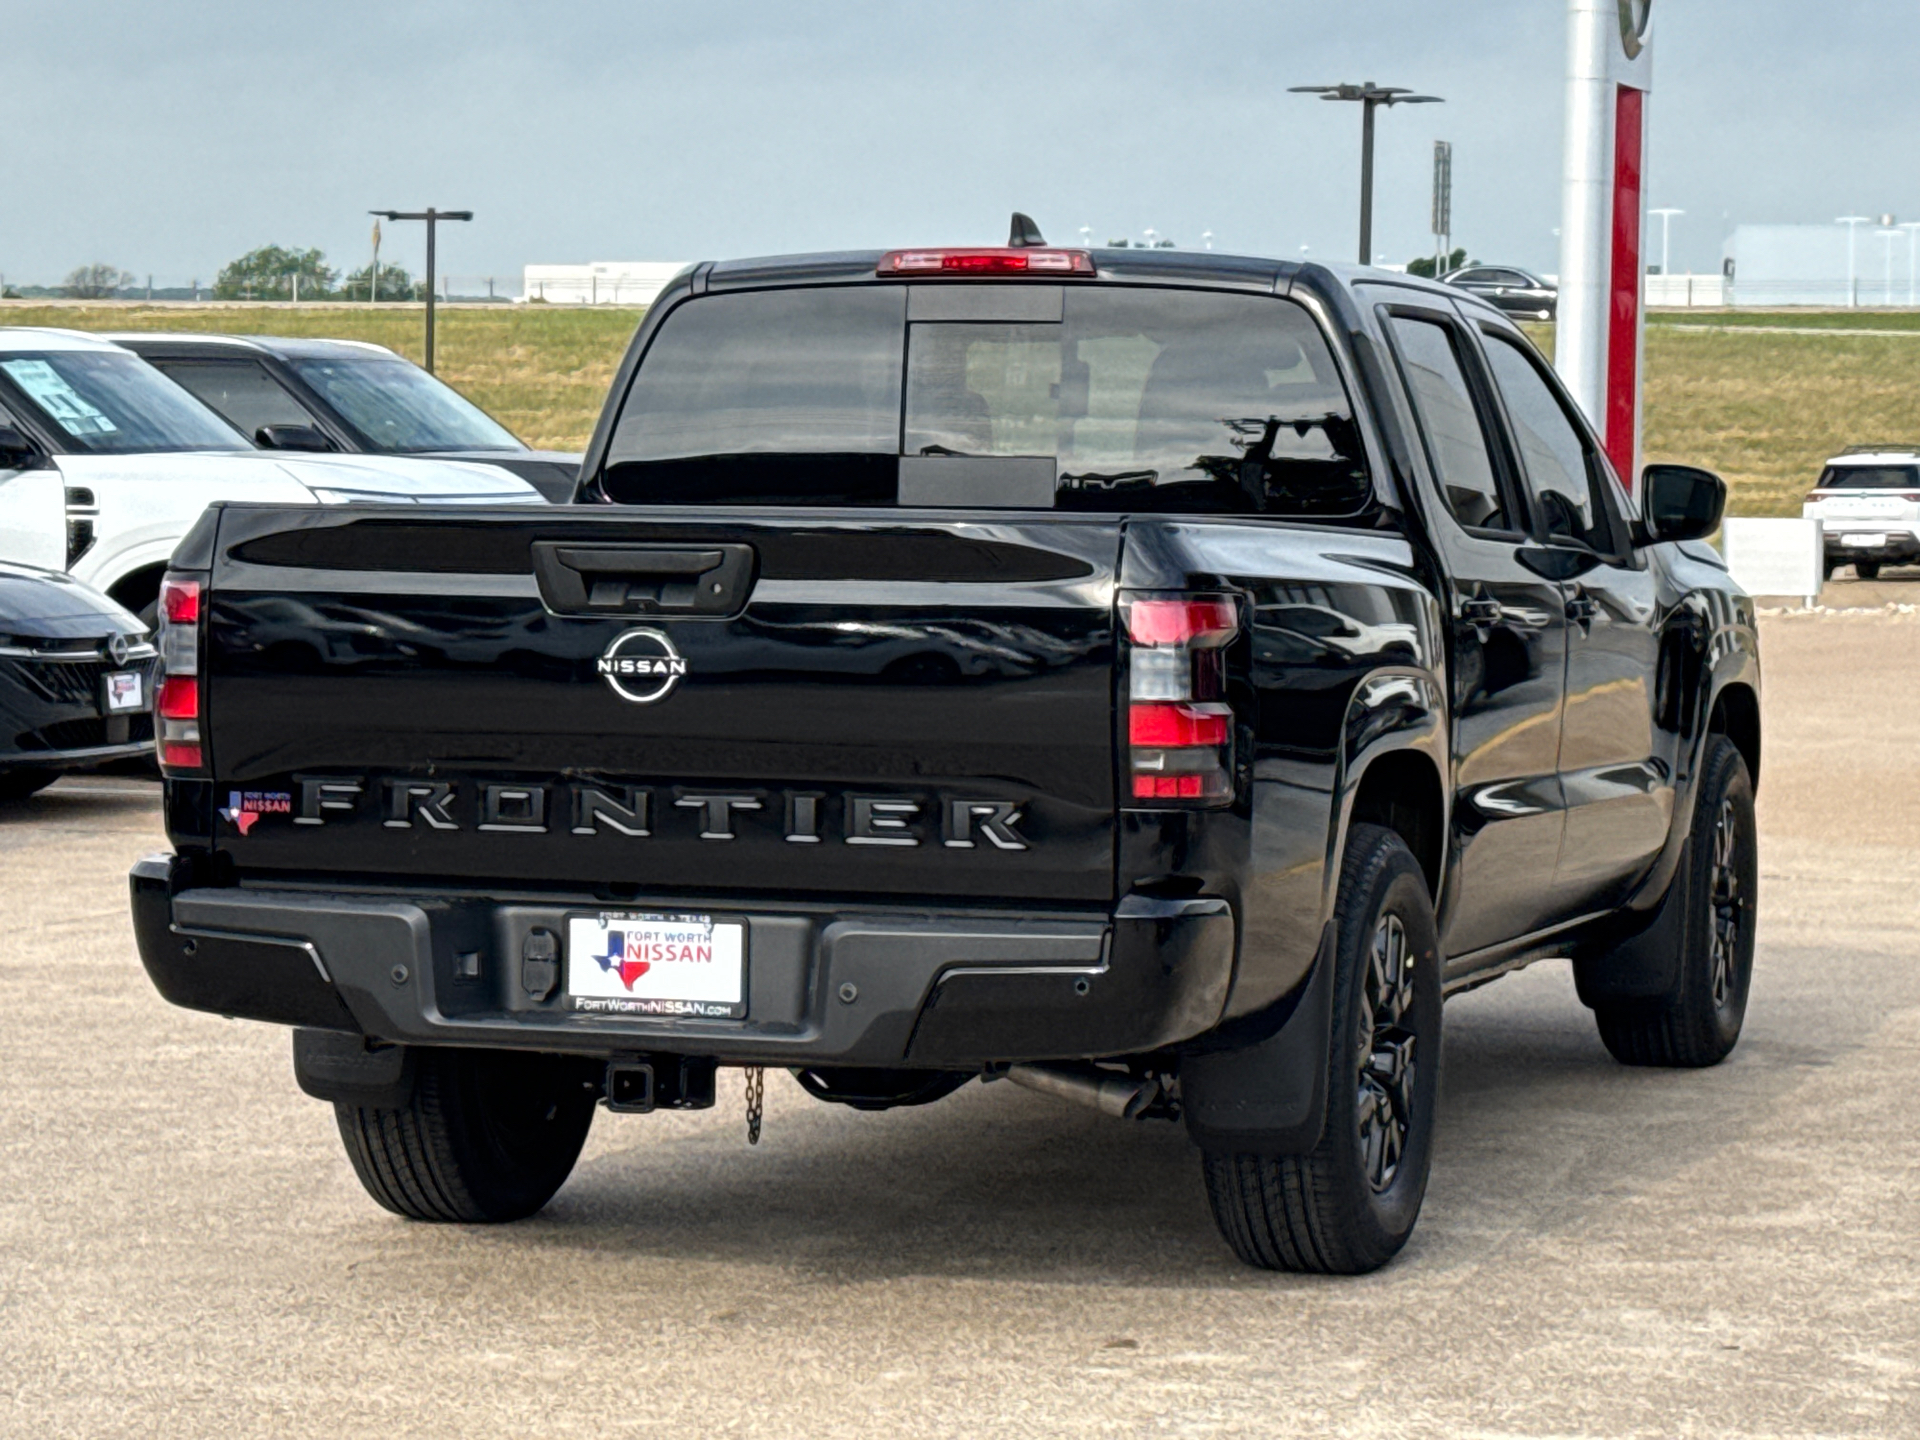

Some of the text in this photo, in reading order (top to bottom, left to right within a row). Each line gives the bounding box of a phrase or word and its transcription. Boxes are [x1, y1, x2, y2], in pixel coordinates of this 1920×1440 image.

[597, 659, 686, 675] NISSAN
[244, 800, 291, 813] NISSAN
[292, 774, 1028, 850] FRONTIER
[627, 931, 712, 943] FORT WORTH
[627, 943, 712, 963] NISSAN
